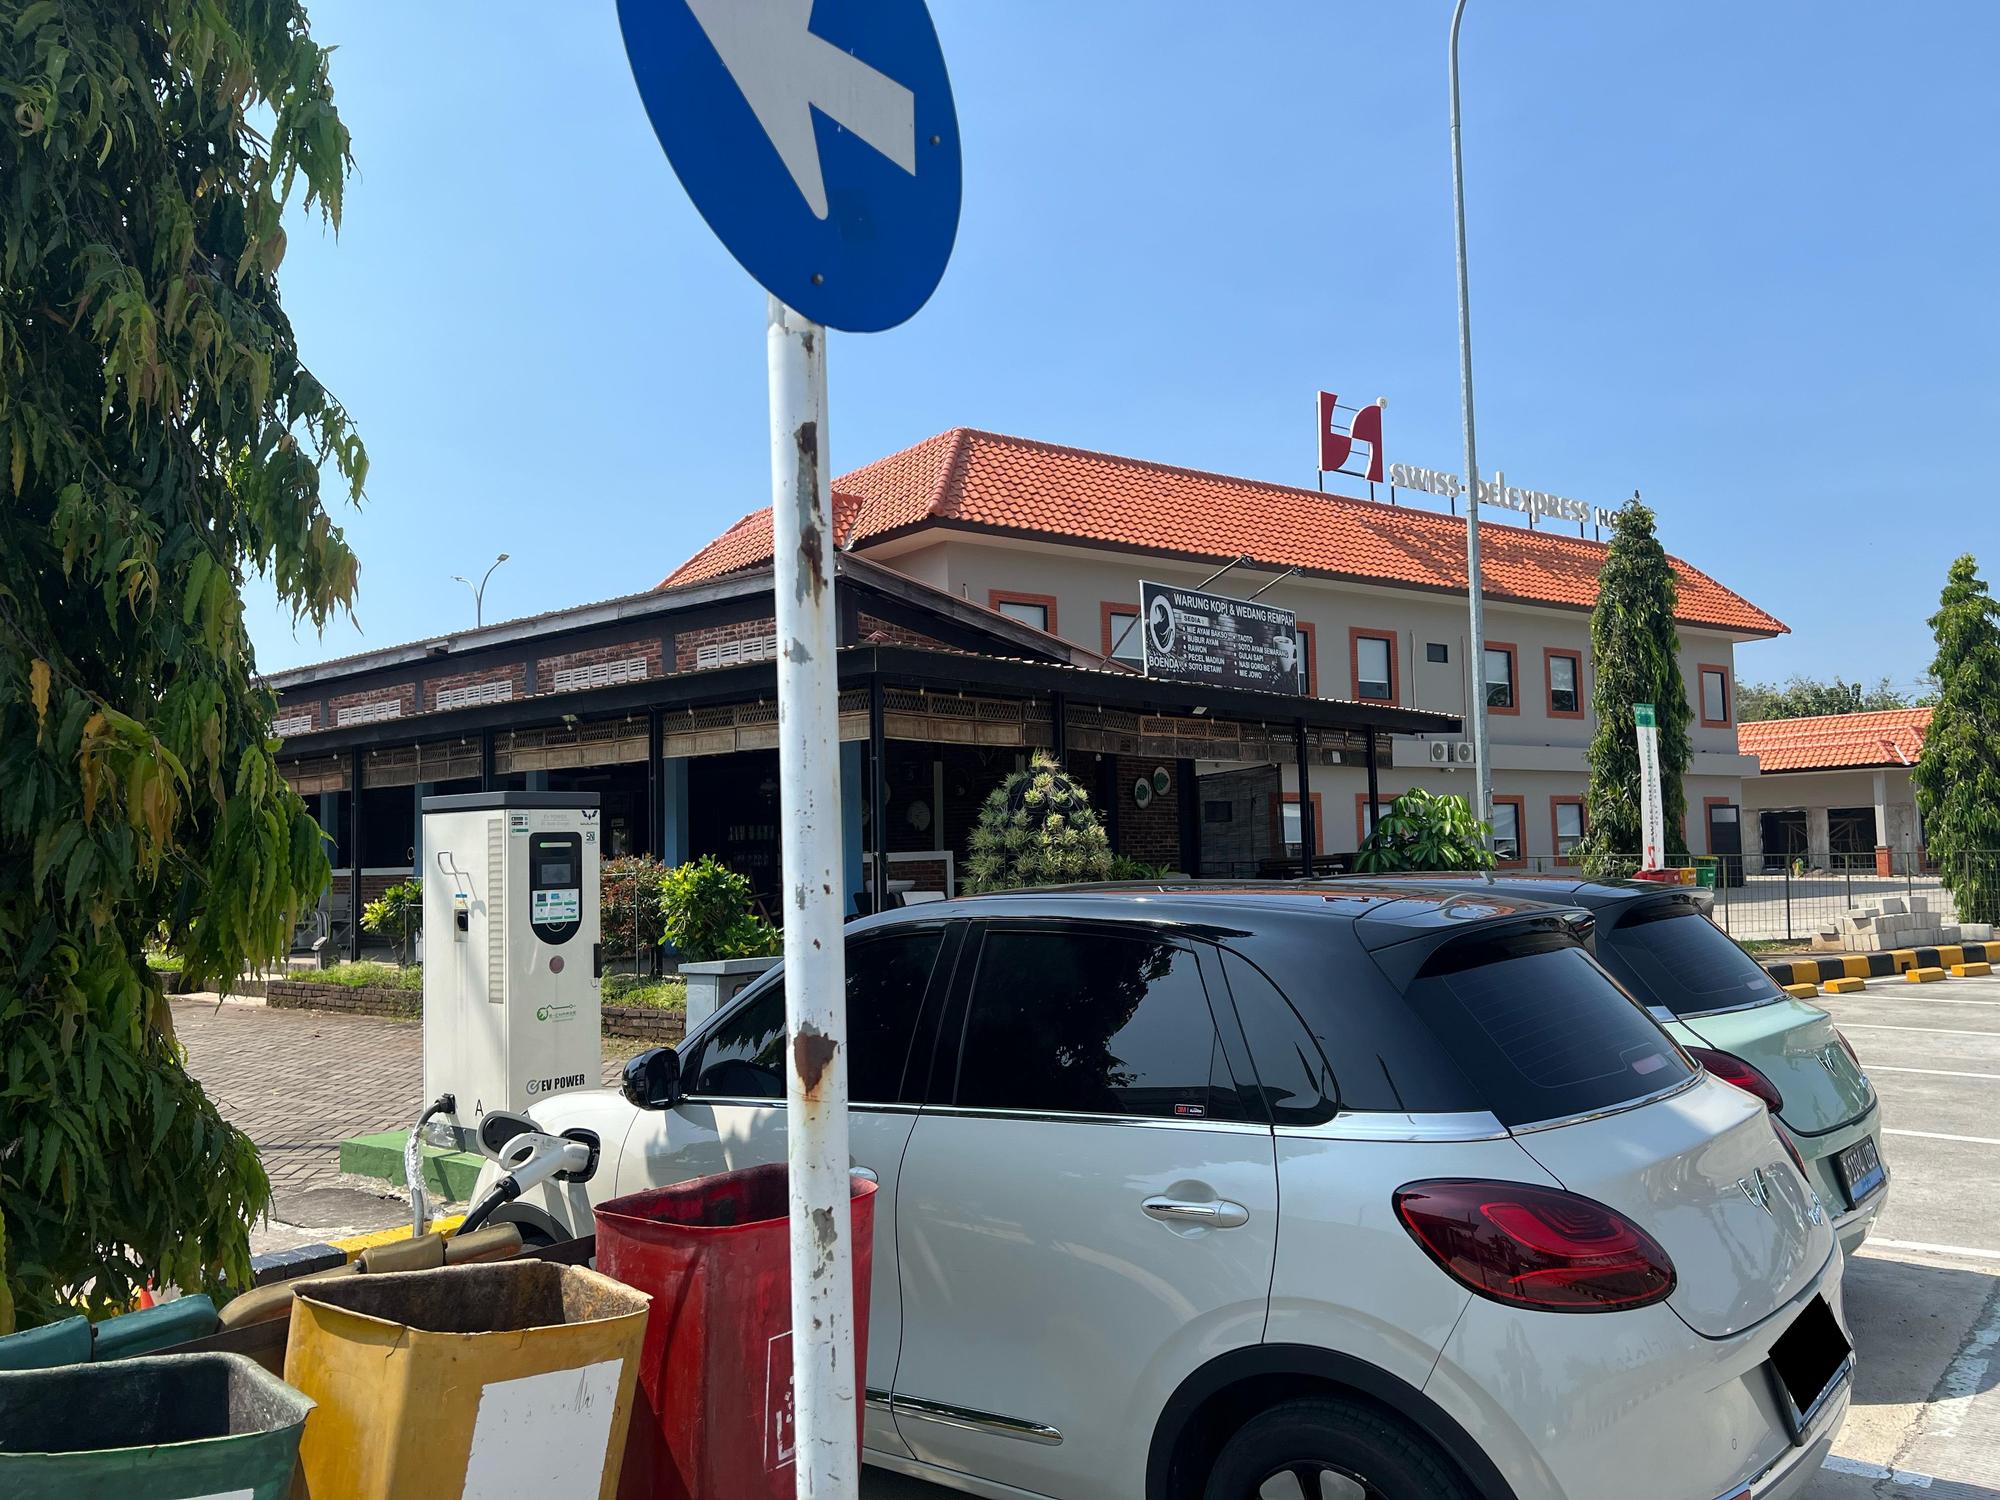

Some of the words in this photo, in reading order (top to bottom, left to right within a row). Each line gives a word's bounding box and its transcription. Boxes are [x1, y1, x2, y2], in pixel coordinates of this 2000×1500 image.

[1173, 593, 1210, 611] WARUNG
[1210, 600, 1228, 614] KOPI
[1229, 604, 1236, 616] &
[1235, 605, 1267, 622] WEDANG
[1267, 611, 1294, 627] REMPAH
[1196, 628, 1211, 637] AYAM
[1210, 630, 1228, 639] BAKSO
[1187, 635, 1205, 644] BUBUR
[1205, 638, 1219, 647] AYAM
[1238, 642, 1251, 652] SOTO
[1251, 645, 1264, 654] AYAM
[1149, 656, 1180, 669] BOENDA
[1188, 653, 1205, 663] PECEL
[1188, 662, 1203, 671] SOTO
[1203, 664, 1223, 674] BETAWI
[1250, 662, 1271, 672] GORENG
[541, 1079, 553, 1092] EV
[554, 1073, 585, 1090] POWER
[475, 1099, 484, 1117] A
